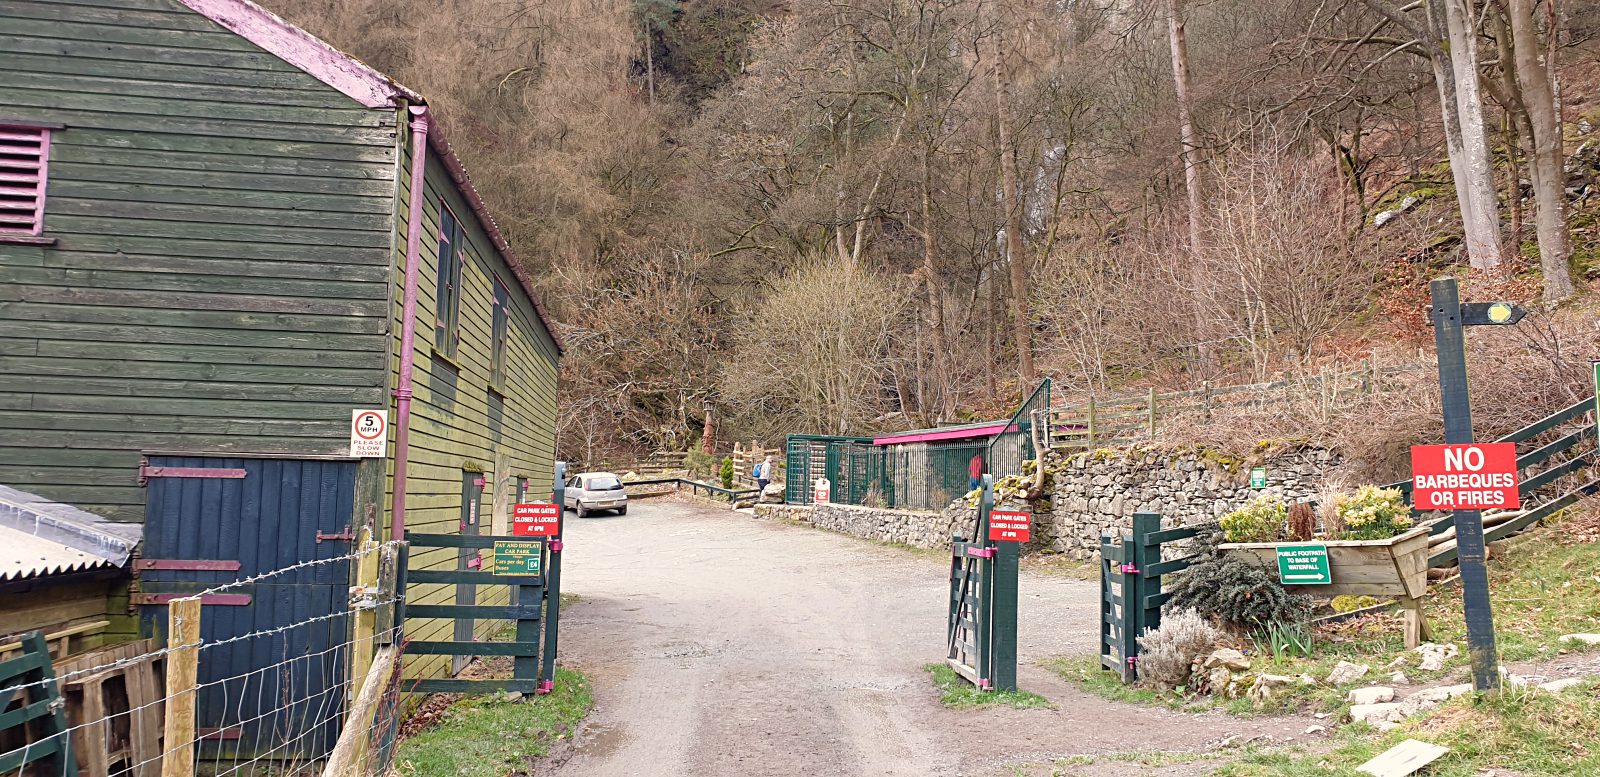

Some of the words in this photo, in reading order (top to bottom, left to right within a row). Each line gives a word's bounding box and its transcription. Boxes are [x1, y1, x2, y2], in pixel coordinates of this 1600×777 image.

[365, 416, 374, 426] 5
[1444, 446, 1485, 472] NO
[1415, 473, 1514, 488] BARBEQUES
[1430, 491, 1454, 505] OR
[1458, 490, 1504, 505] FIRES
